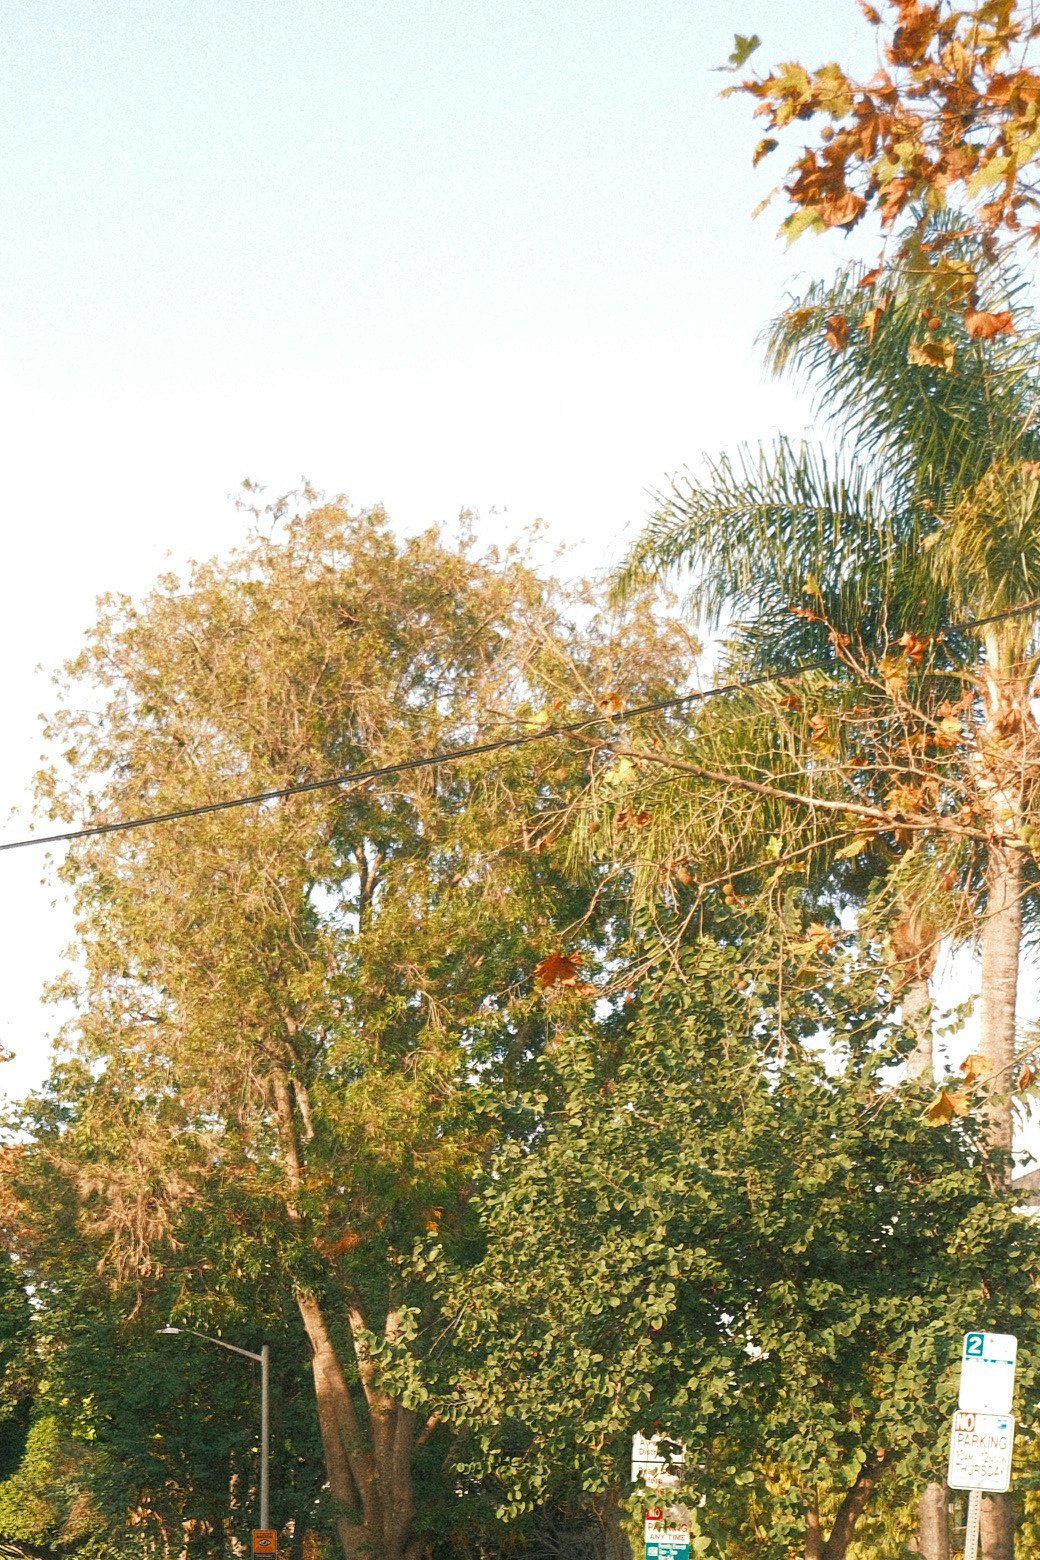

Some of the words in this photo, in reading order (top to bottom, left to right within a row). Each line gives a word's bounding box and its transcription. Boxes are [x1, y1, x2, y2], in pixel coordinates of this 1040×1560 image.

[967, 1336, 983, 1355] 2
[955, 1413, 975, 1432] NO
[957, 1433, 1007, 1450] PARKING
[955, 1462, 1006, 1477] THURSDAY
